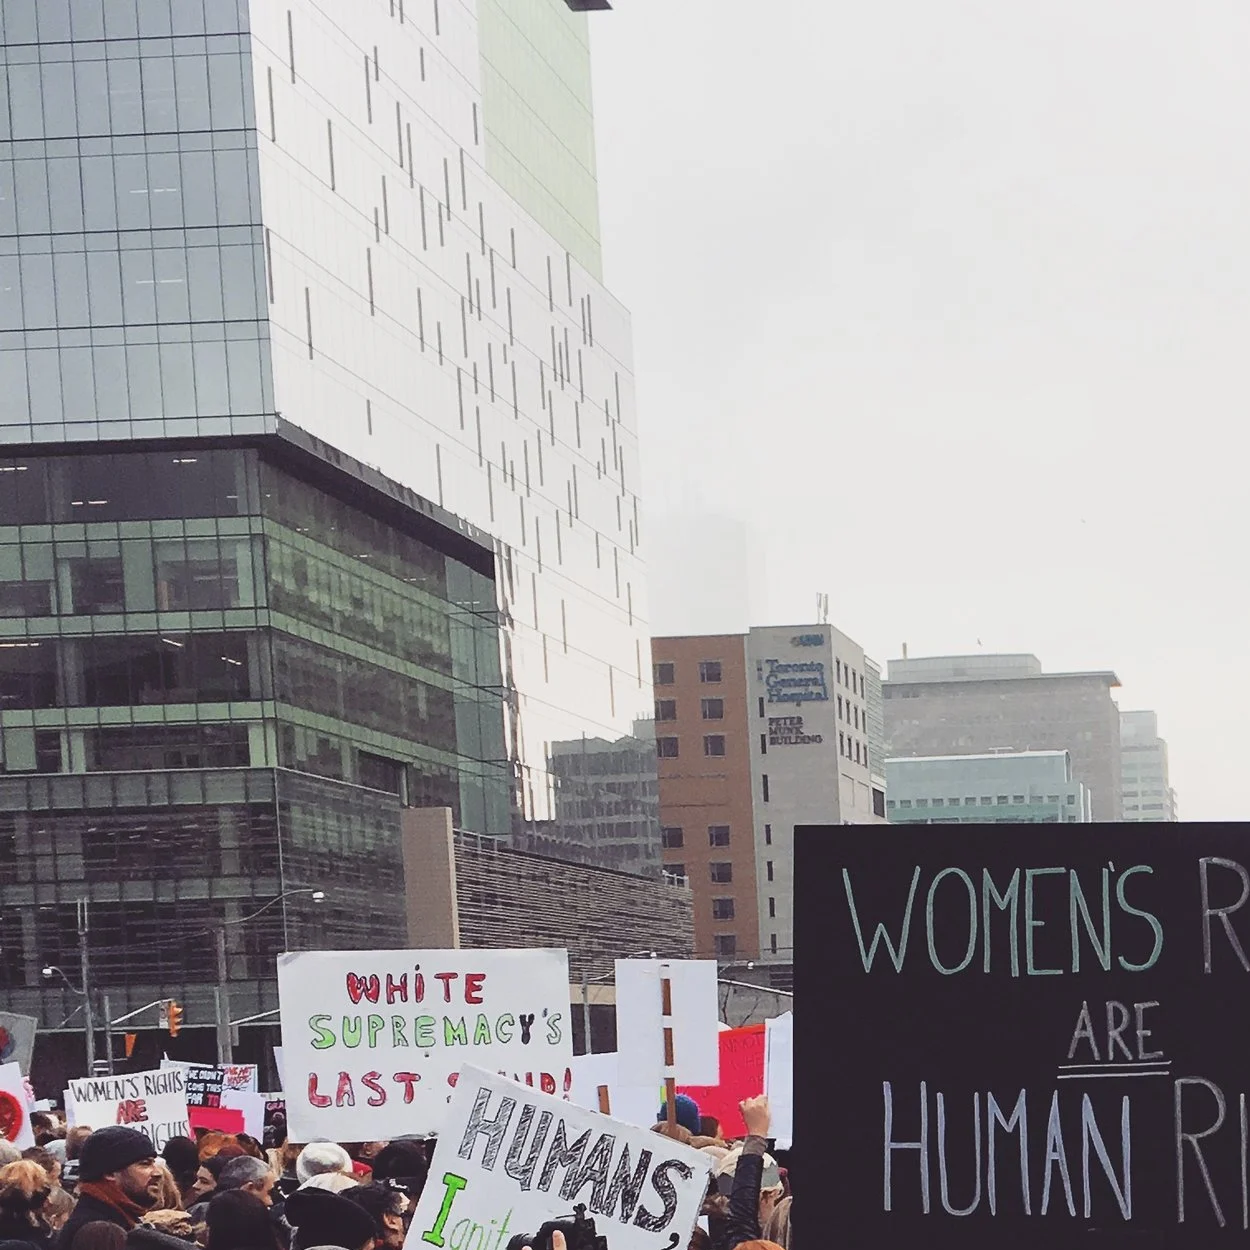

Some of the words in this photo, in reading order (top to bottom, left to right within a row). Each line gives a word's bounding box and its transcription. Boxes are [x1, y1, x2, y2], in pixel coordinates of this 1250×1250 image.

[769, 735, 823, 745] BUILDING
[842, 860, 1164, 977] WOMEN'S
[308, 1007, 562, 1049] SUPREMACY'S
[1066, 1000, 1165, 1061] ARE
[71, 1076, 139, 1102] WOMEN'S
[144, 1071, 184, 1096] RIGHTS
[308, 1070, 421, 1108] LAST
[116, 1099, 148, 1124] ARE
[456, 1087, 696, 1250] HUMANS,
[882, 1080, 1132, 1220] HUMAN
